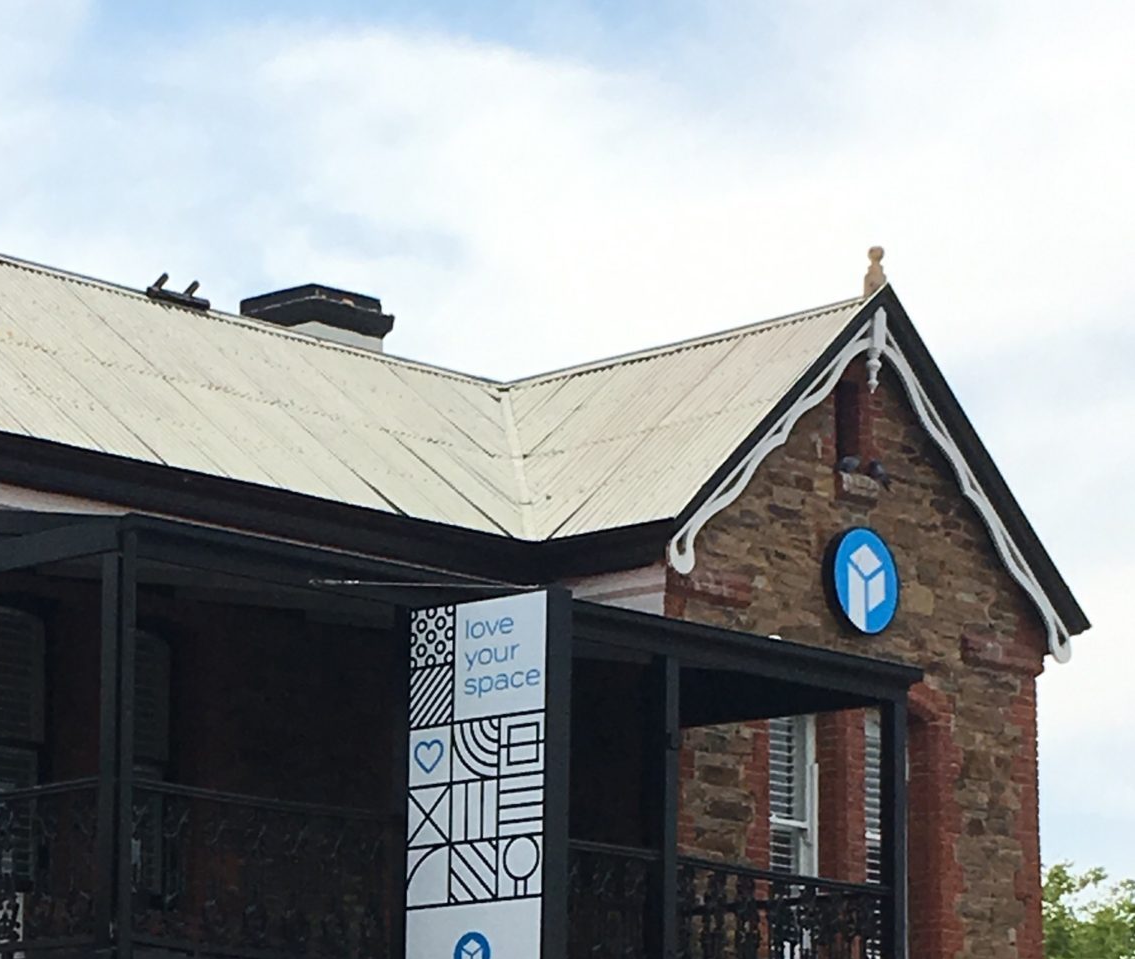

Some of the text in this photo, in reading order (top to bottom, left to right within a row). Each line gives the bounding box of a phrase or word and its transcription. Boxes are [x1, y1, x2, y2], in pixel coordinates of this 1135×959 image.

[466, 616, 514, 639] love
[465, 643, 520, 671] your
[465, 668, 541, 698] space
